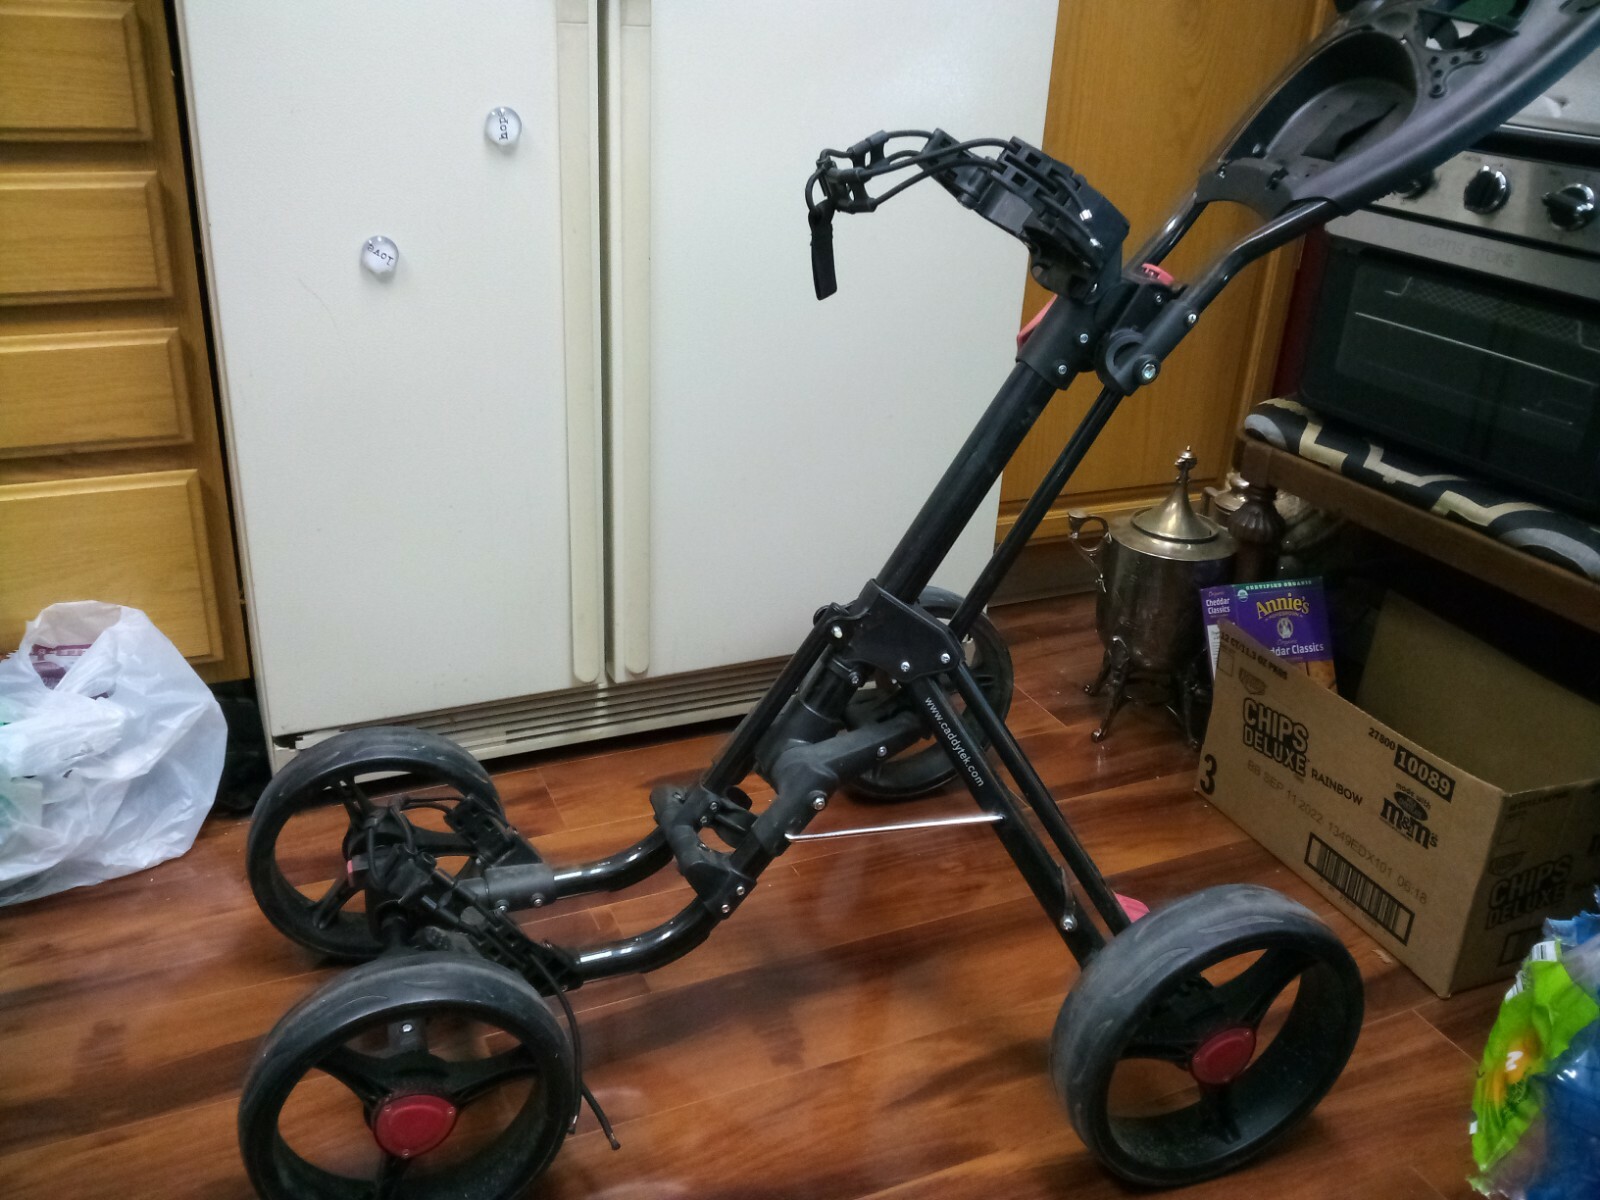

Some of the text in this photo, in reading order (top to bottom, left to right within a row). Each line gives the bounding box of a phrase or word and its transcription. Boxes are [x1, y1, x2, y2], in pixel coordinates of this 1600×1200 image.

[367, 243, 394, 266] love
[1206, 597, 1231, 607] Cheddar
[1207, 605, 1231, 615] Classics
[1256, 592, 1310, 620] Annie's
[1291, 642, 1325, 655] Classics
[925, 697, 984, 787] www.caddytek.com
[1242, 697, 1309, 753] CHIPS
[1242, 725, 1307, 778] DELUXE
[1398, 750, 1453, 797] 10089
[1200, 754, 1218, 796] 3
[1311, 768, 1364, 806] RAINBOW
[1263, 771, 1284, 791] SEP
[1298, 797, 1324, 824] 2022
[1489, 854, 1573, 910] CHIPS
[1485, 883, 1568, 930] DELUXE
